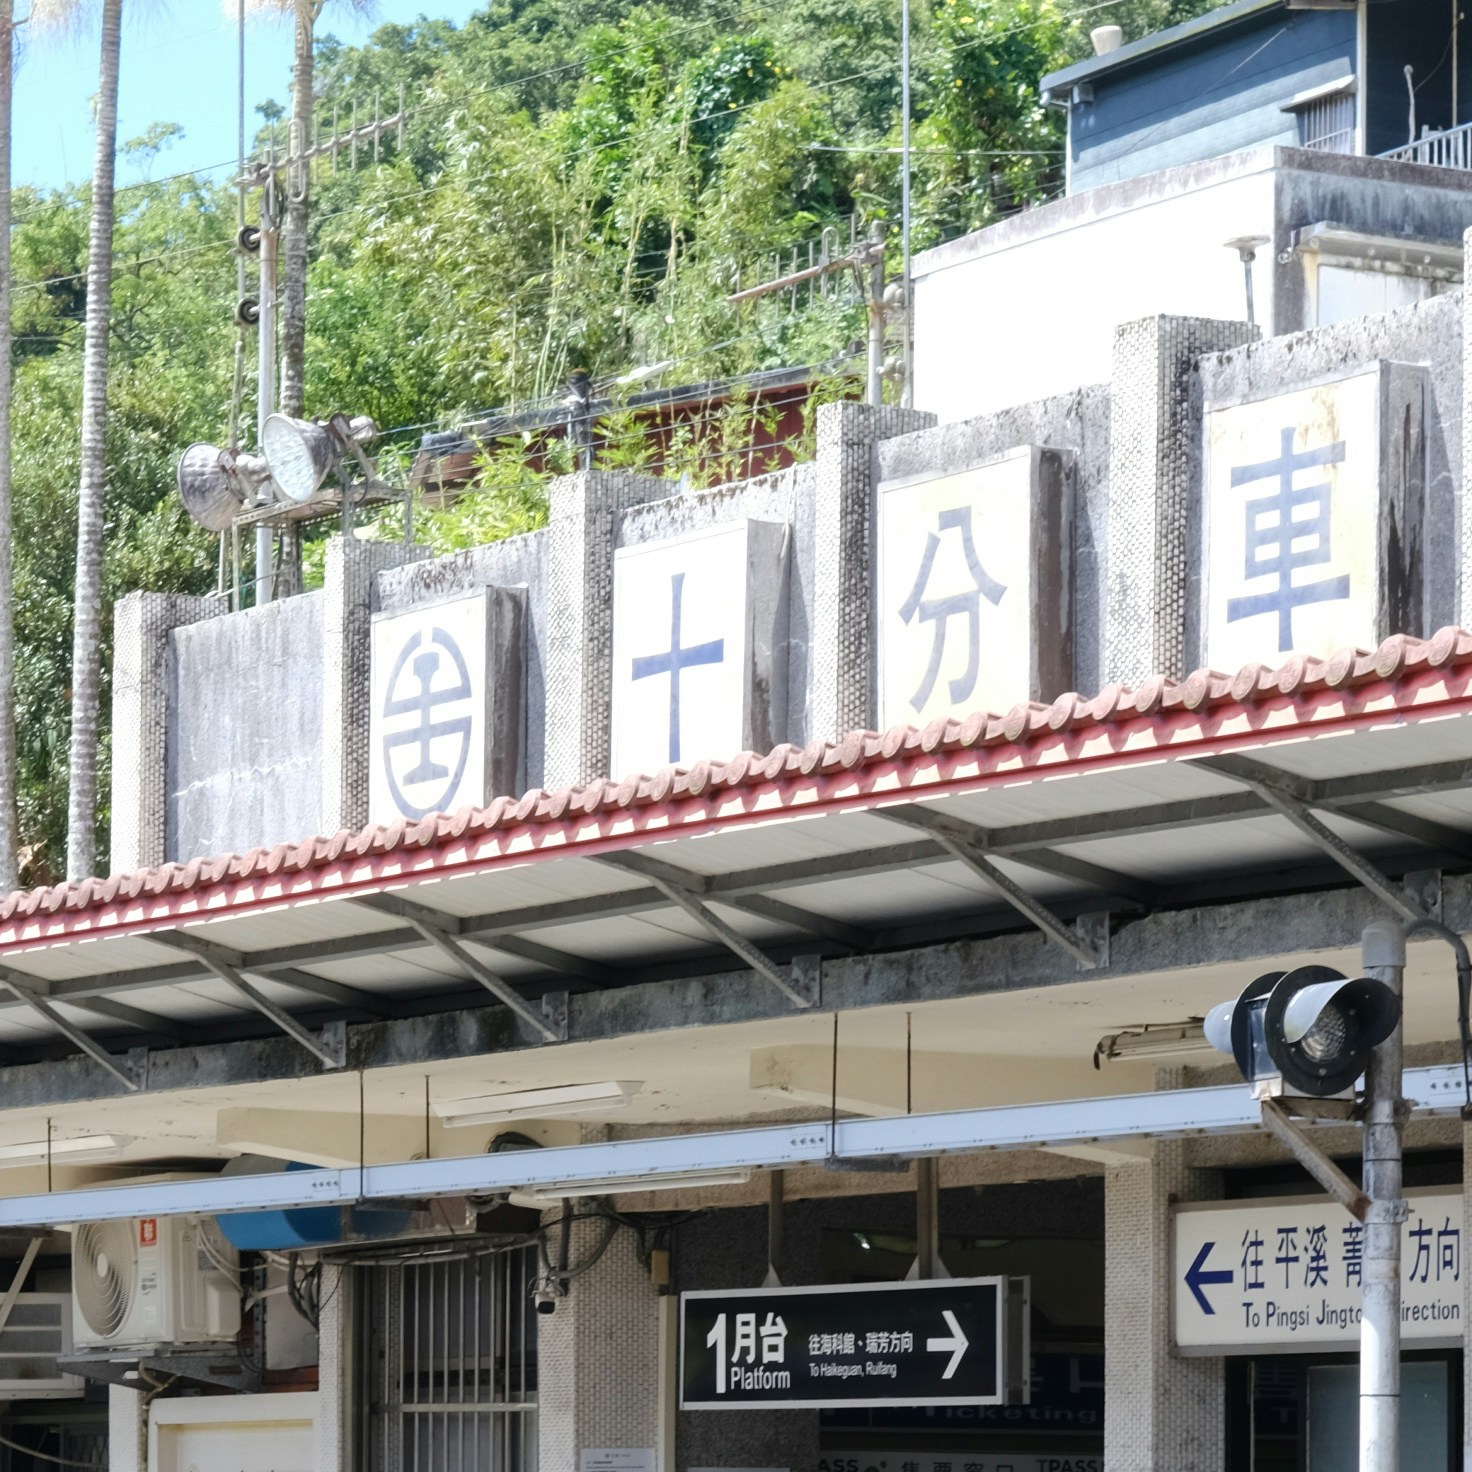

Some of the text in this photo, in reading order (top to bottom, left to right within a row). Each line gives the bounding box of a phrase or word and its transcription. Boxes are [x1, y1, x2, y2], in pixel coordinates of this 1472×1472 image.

[1242, 1301, 1260, 1329] To
[1265, 1300, 1311, 1331] Pingsi
[1400, 1299, 1461, 1322] irection
[731, 1311, 789, 1364] 月台
[730, 1365, 791, 1391] Platform
